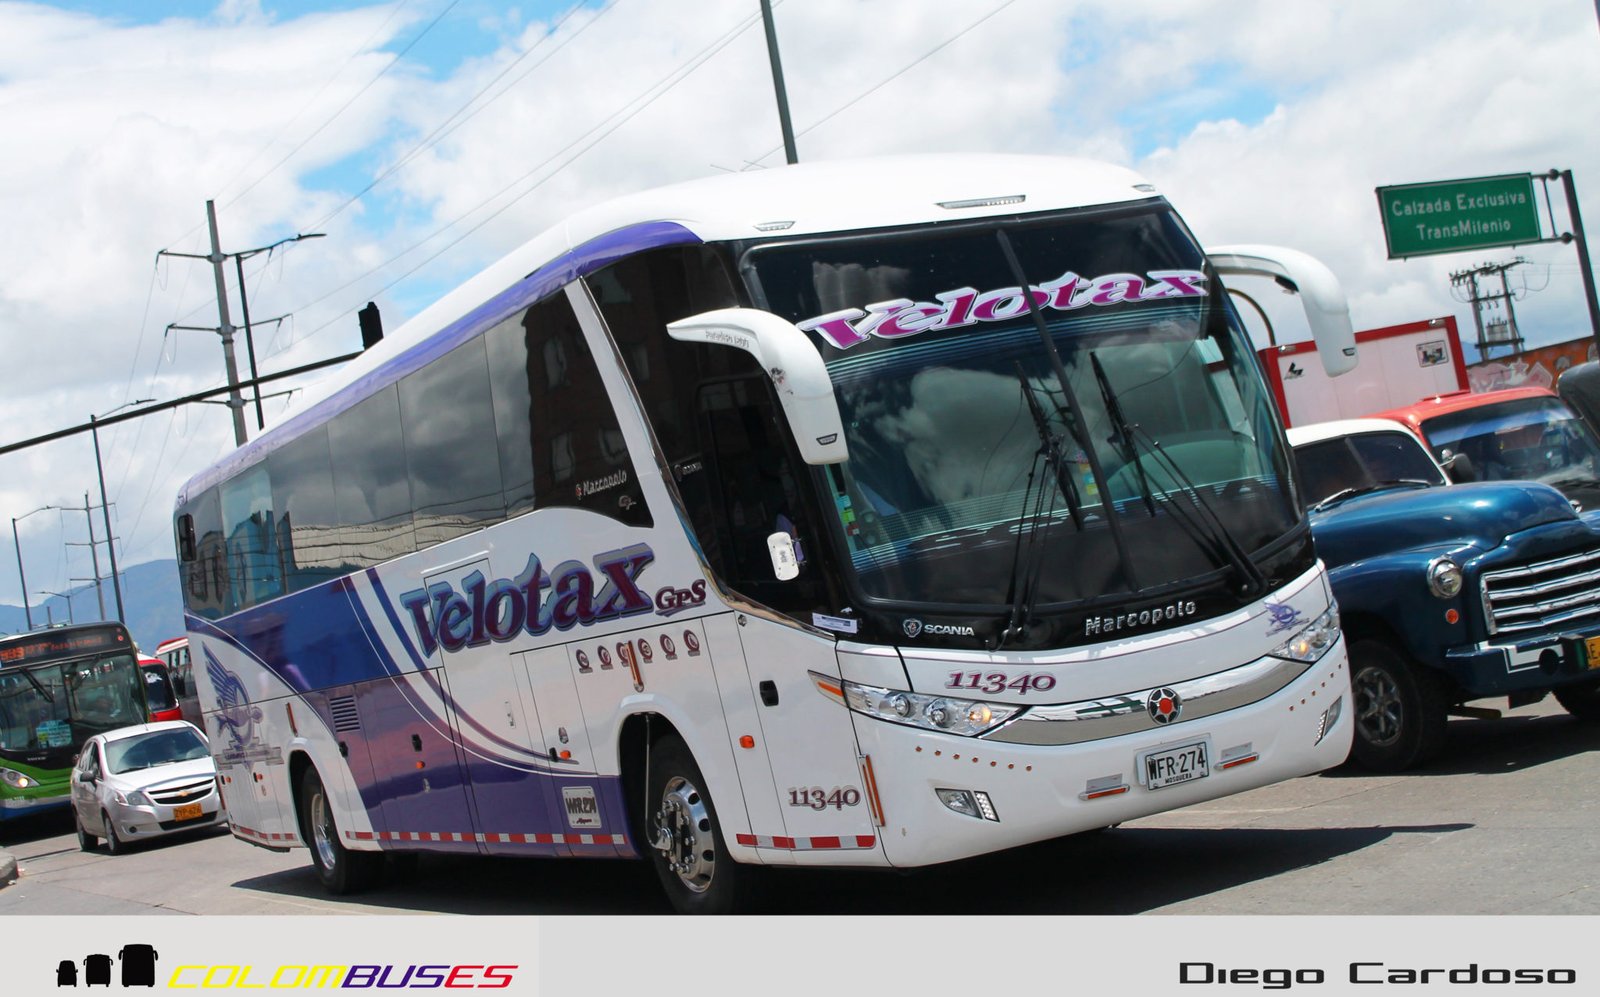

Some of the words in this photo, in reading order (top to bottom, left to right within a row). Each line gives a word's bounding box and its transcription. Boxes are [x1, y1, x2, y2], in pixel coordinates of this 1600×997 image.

[1391, 197, 1452, 217] Calzada
[1456, 191, 1527, 211] Exclusiva
[1416, 219, 1512, 241] TransMilenio
[796, 270, 1209, 350] Velotax
[583, 469, 628, 496] Marcopolo
[399, 542, 655, 659] Velotax
[655, 578, 707, 613] GPS
[924, 624, 975, 637] SCANIA
[1085, 600, 1197, 636] Marcopolo
[945, 669, 1057, 695] 11340
[788, 785, 861, 811] 11340
